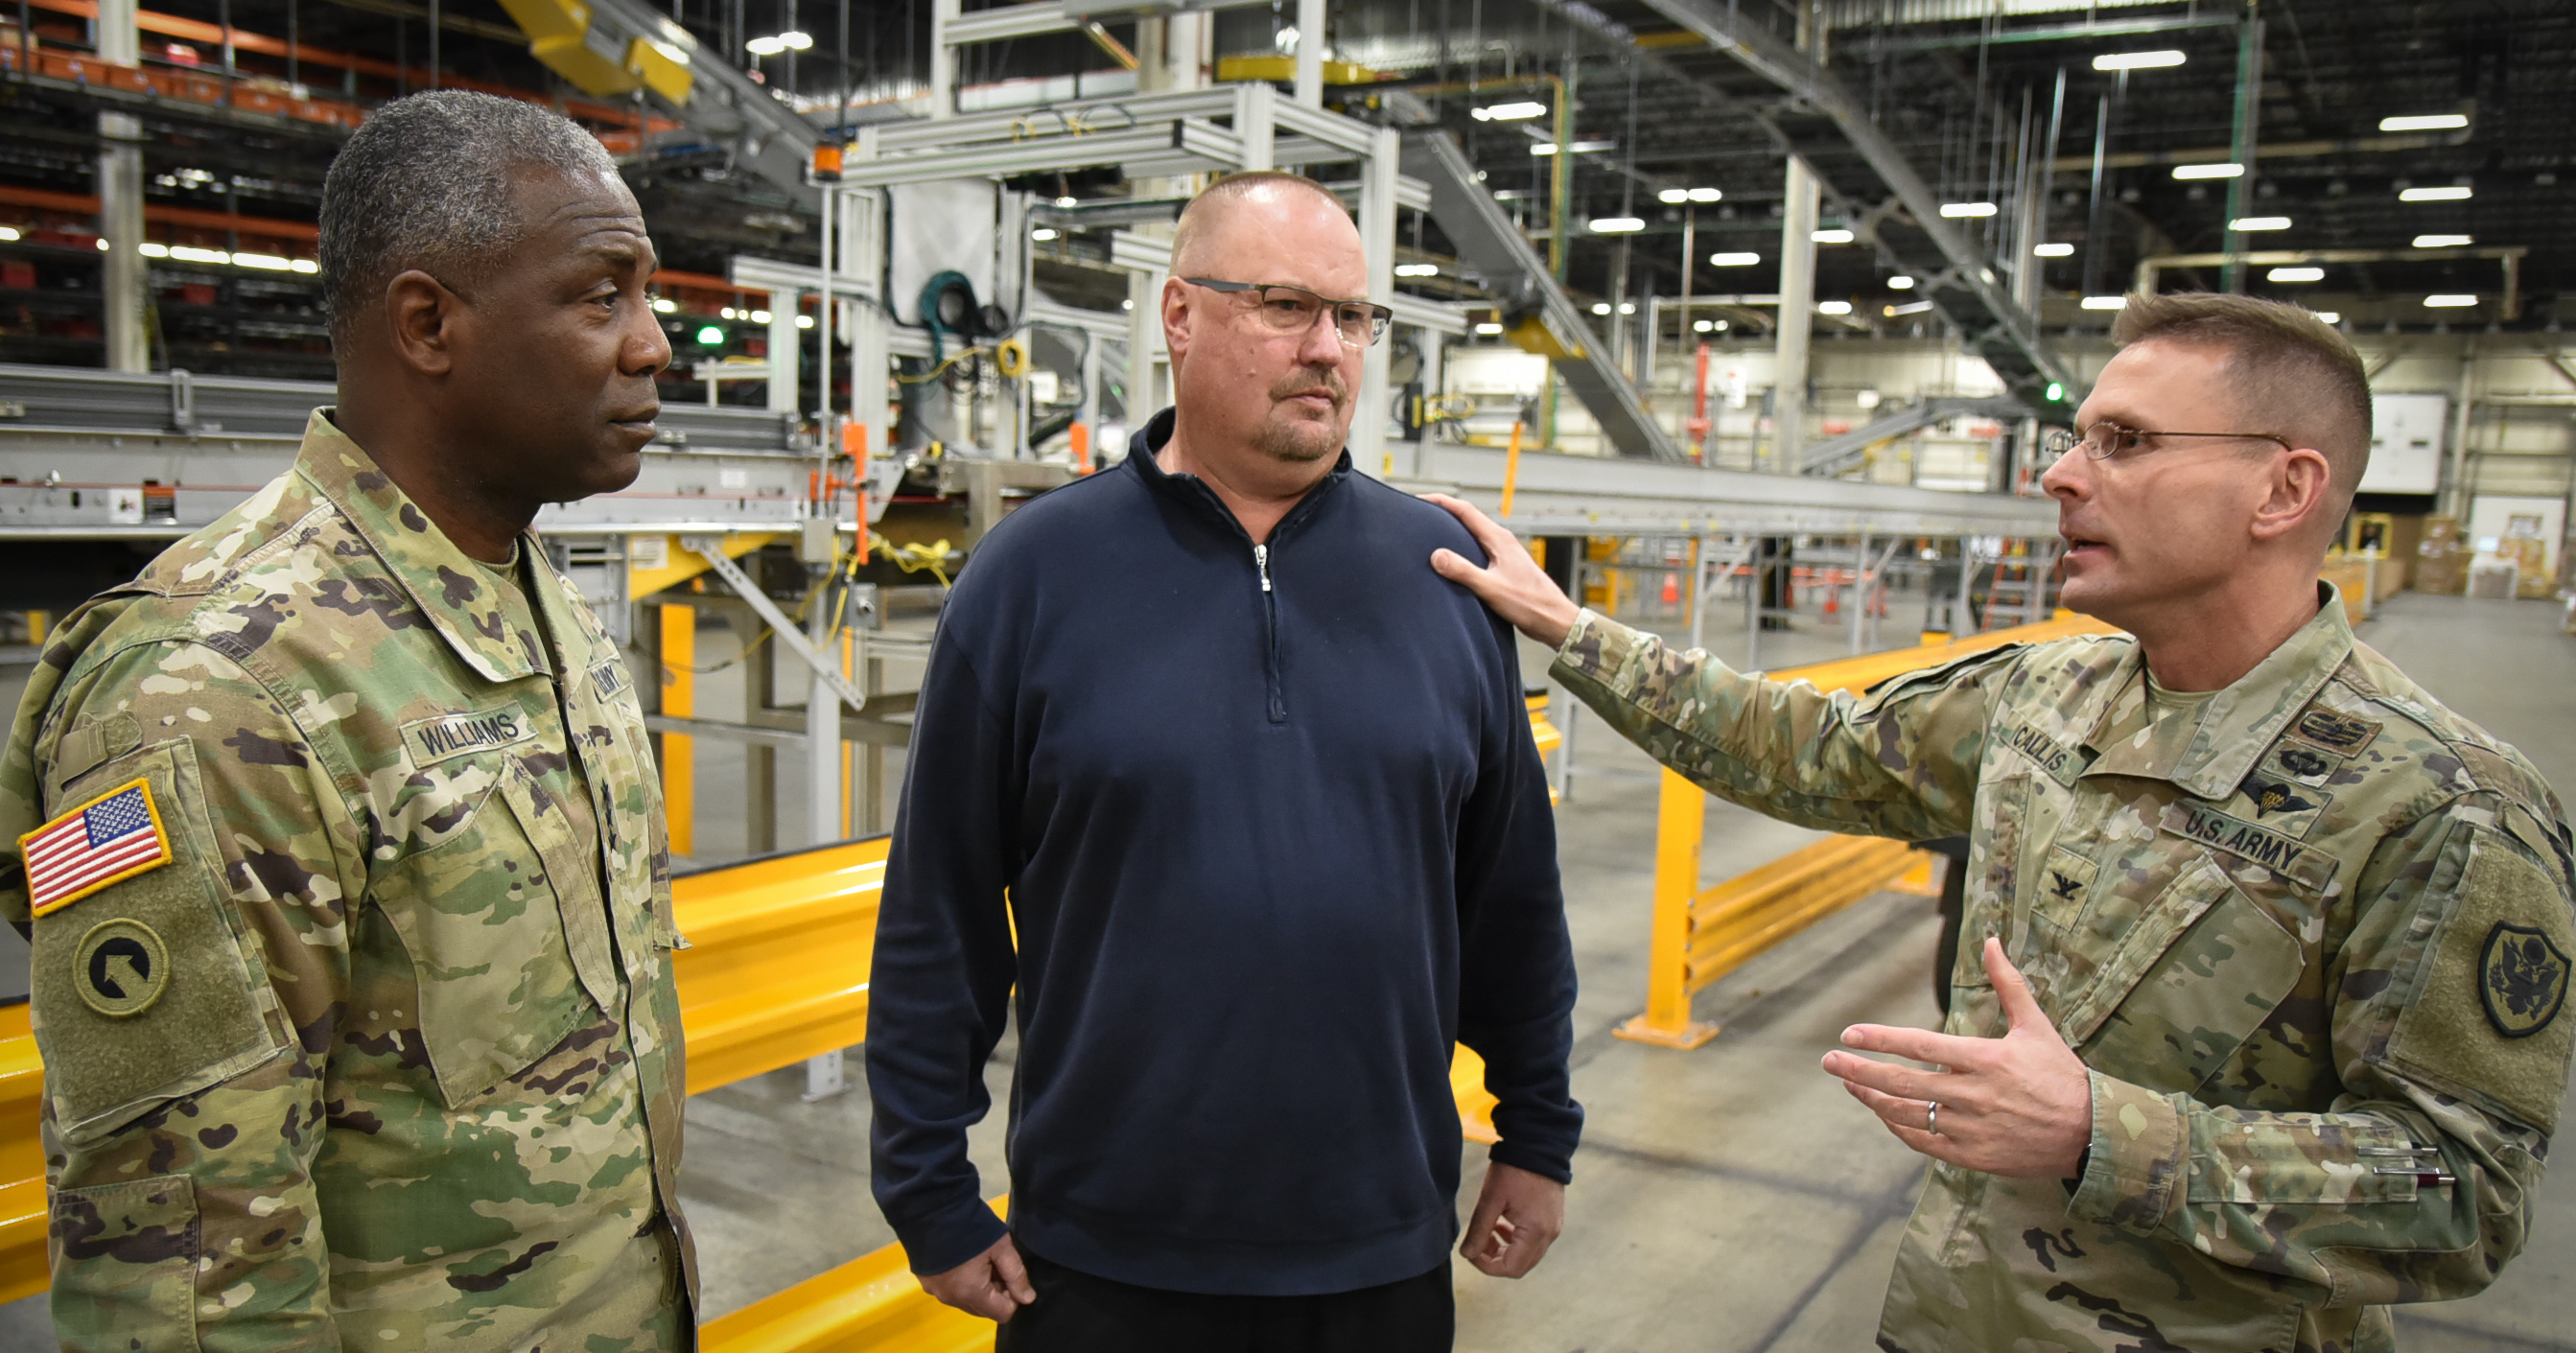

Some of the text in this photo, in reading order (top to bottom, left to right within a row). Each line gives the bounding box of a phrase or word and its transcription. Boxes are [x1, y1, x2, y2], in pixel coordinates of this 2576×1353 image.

[417, 713, 519, 757] WILLIAMS
[2013, 726, 2068, 771] CALLIS
[2186, 809, 2303, 870] U.S. ARMY
